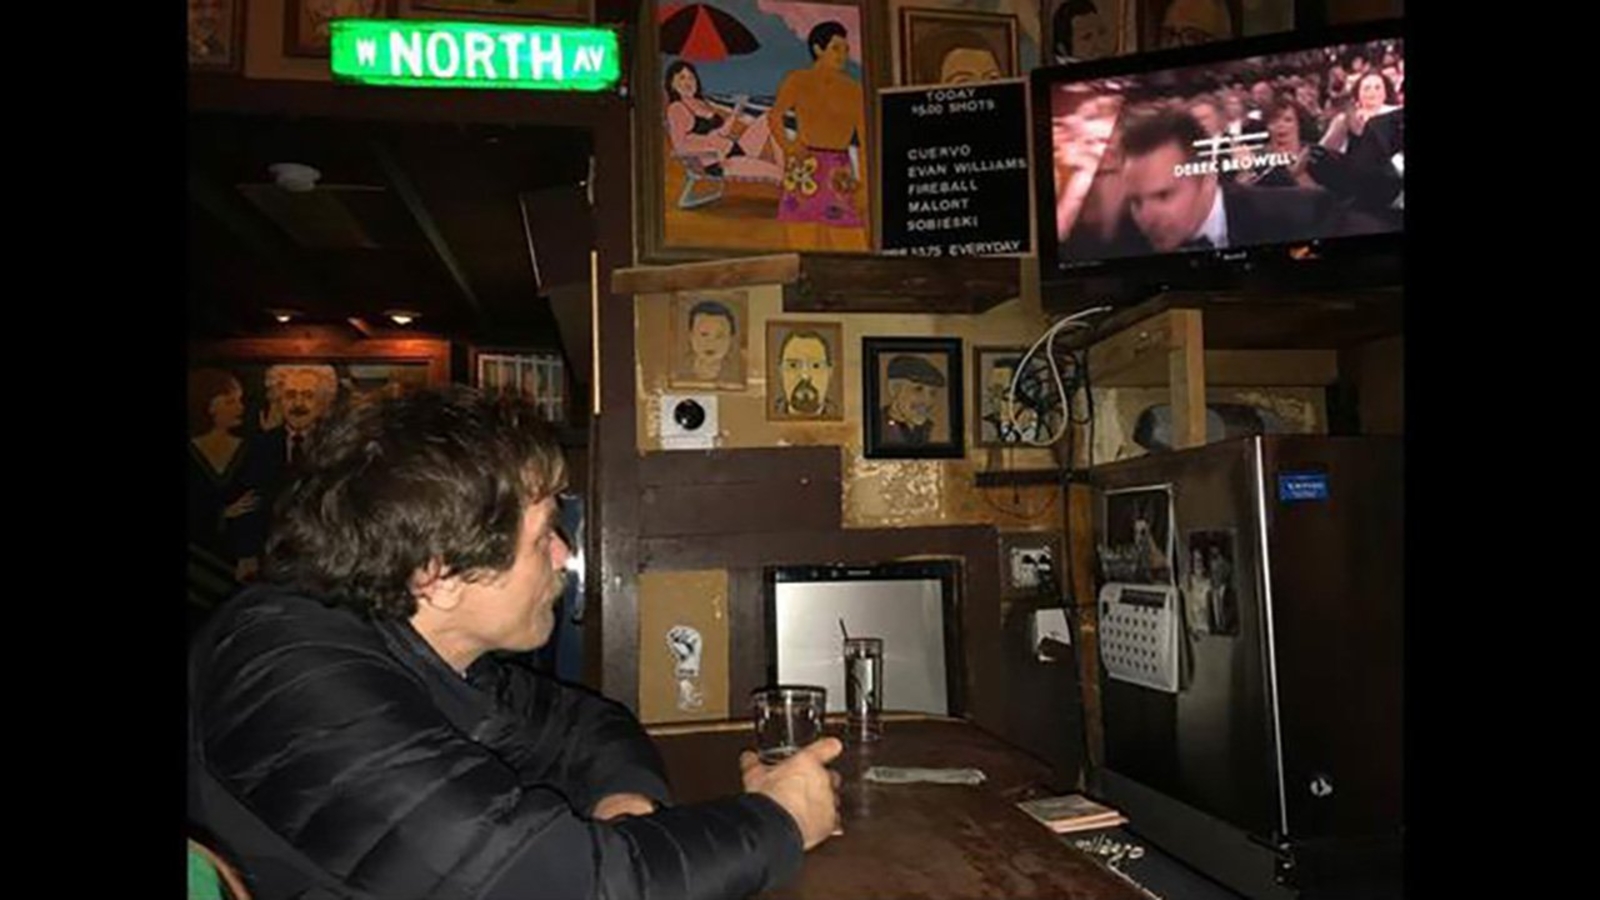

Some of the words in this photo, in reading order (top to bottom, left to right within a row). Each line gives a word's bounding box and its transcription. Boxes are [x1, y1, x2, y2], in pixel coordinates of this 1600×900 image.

[356, 38, 376, 67] W
[389, 31, 564, 80] NORTH
[573, 45, 604, 72] AV
[926, 88, 976, 102] TODAY
[949, 99, 995, 114] SHOTS
[907, 144, 971, 161] CUERVO
[907, 164, 947, 179] EVAN
[953, 157, 1027, 175] WILLIAMS
[1174, 161, 1219, 177] DEREK
[908, 179, 978, 196] FIREBALL
[908, 197, 969, 213] MALORT
[907, 215, 978, 232] SOBIESKI
[949, 239, 1021, 256] EVERYDAY
